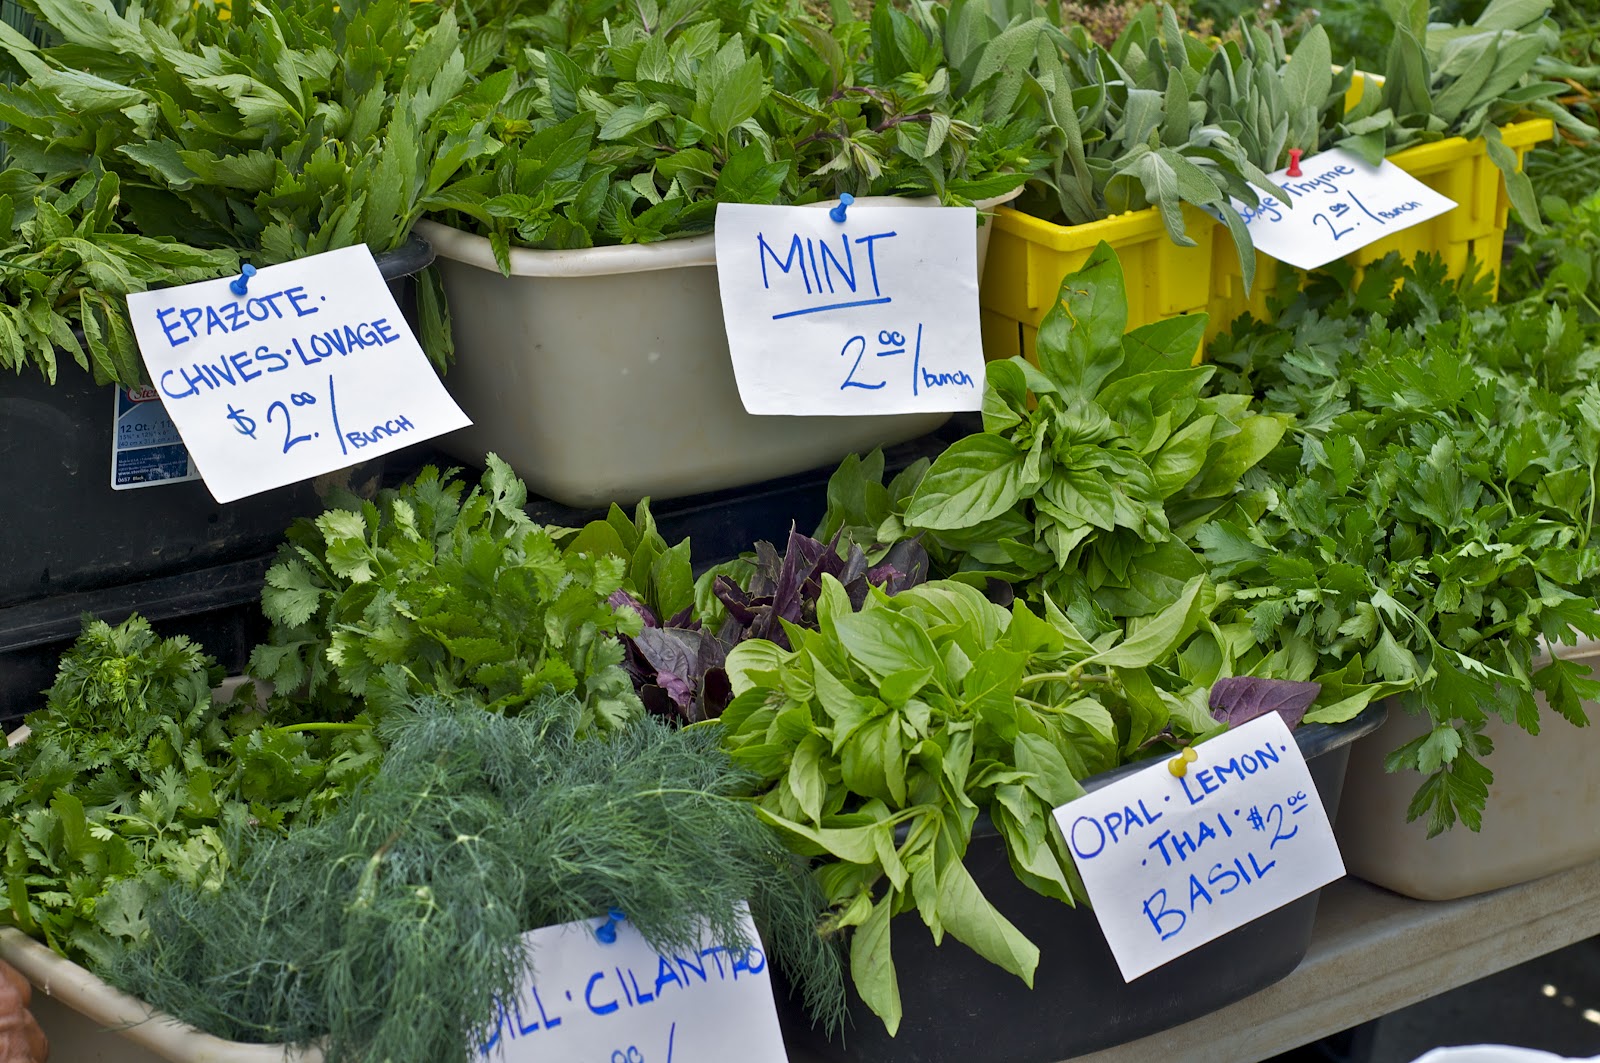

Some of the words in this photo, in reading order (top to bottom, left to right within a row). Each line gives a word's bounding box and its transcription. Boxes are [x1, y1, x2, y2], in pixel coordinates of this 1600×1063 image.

[1281, 163, 1355, 197] Thyme
[757, 231, 897, 297] MINT
[921, 367, 974, 389] bunch
[120, 424, 132, 434] 12
[134, 423, 150, 432] Qt.
[1142, 851, 1277, 942] BASIL
[584, 945, 766, 1017] CILANTRO
